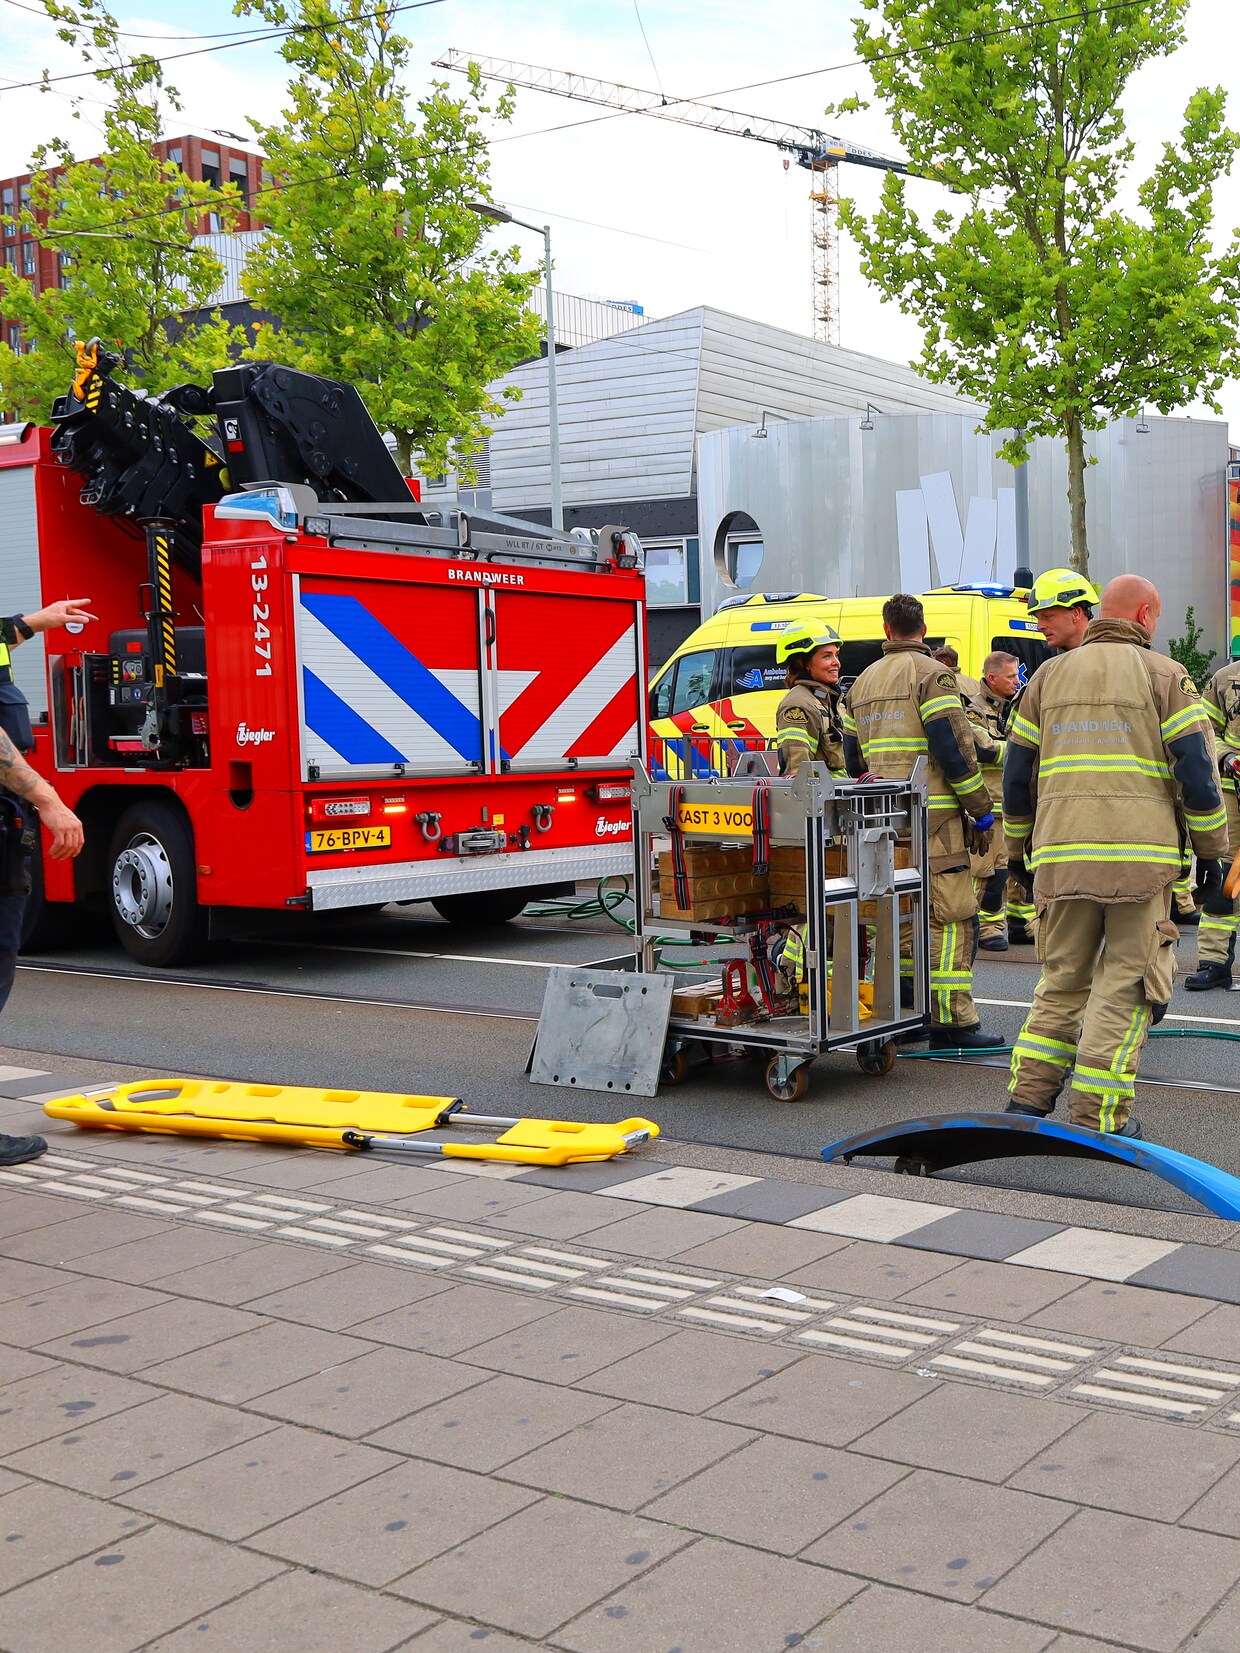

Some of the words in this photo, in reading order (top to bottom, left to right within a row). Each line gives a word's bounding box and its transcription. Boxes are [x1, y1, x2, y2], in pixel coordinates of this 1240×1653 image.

[505, 540, 520, 549] WLL
[447, 568, 525, 585] BRANDWEER
[250, 555, 272, 676] 13-2471
[236, 722, 275, 747] Ziegler
[595, 816, 632, 837] Ziegler
[713, 811, 720, 825] 3
[316, 829, 385, 849] 76-BPV-4
